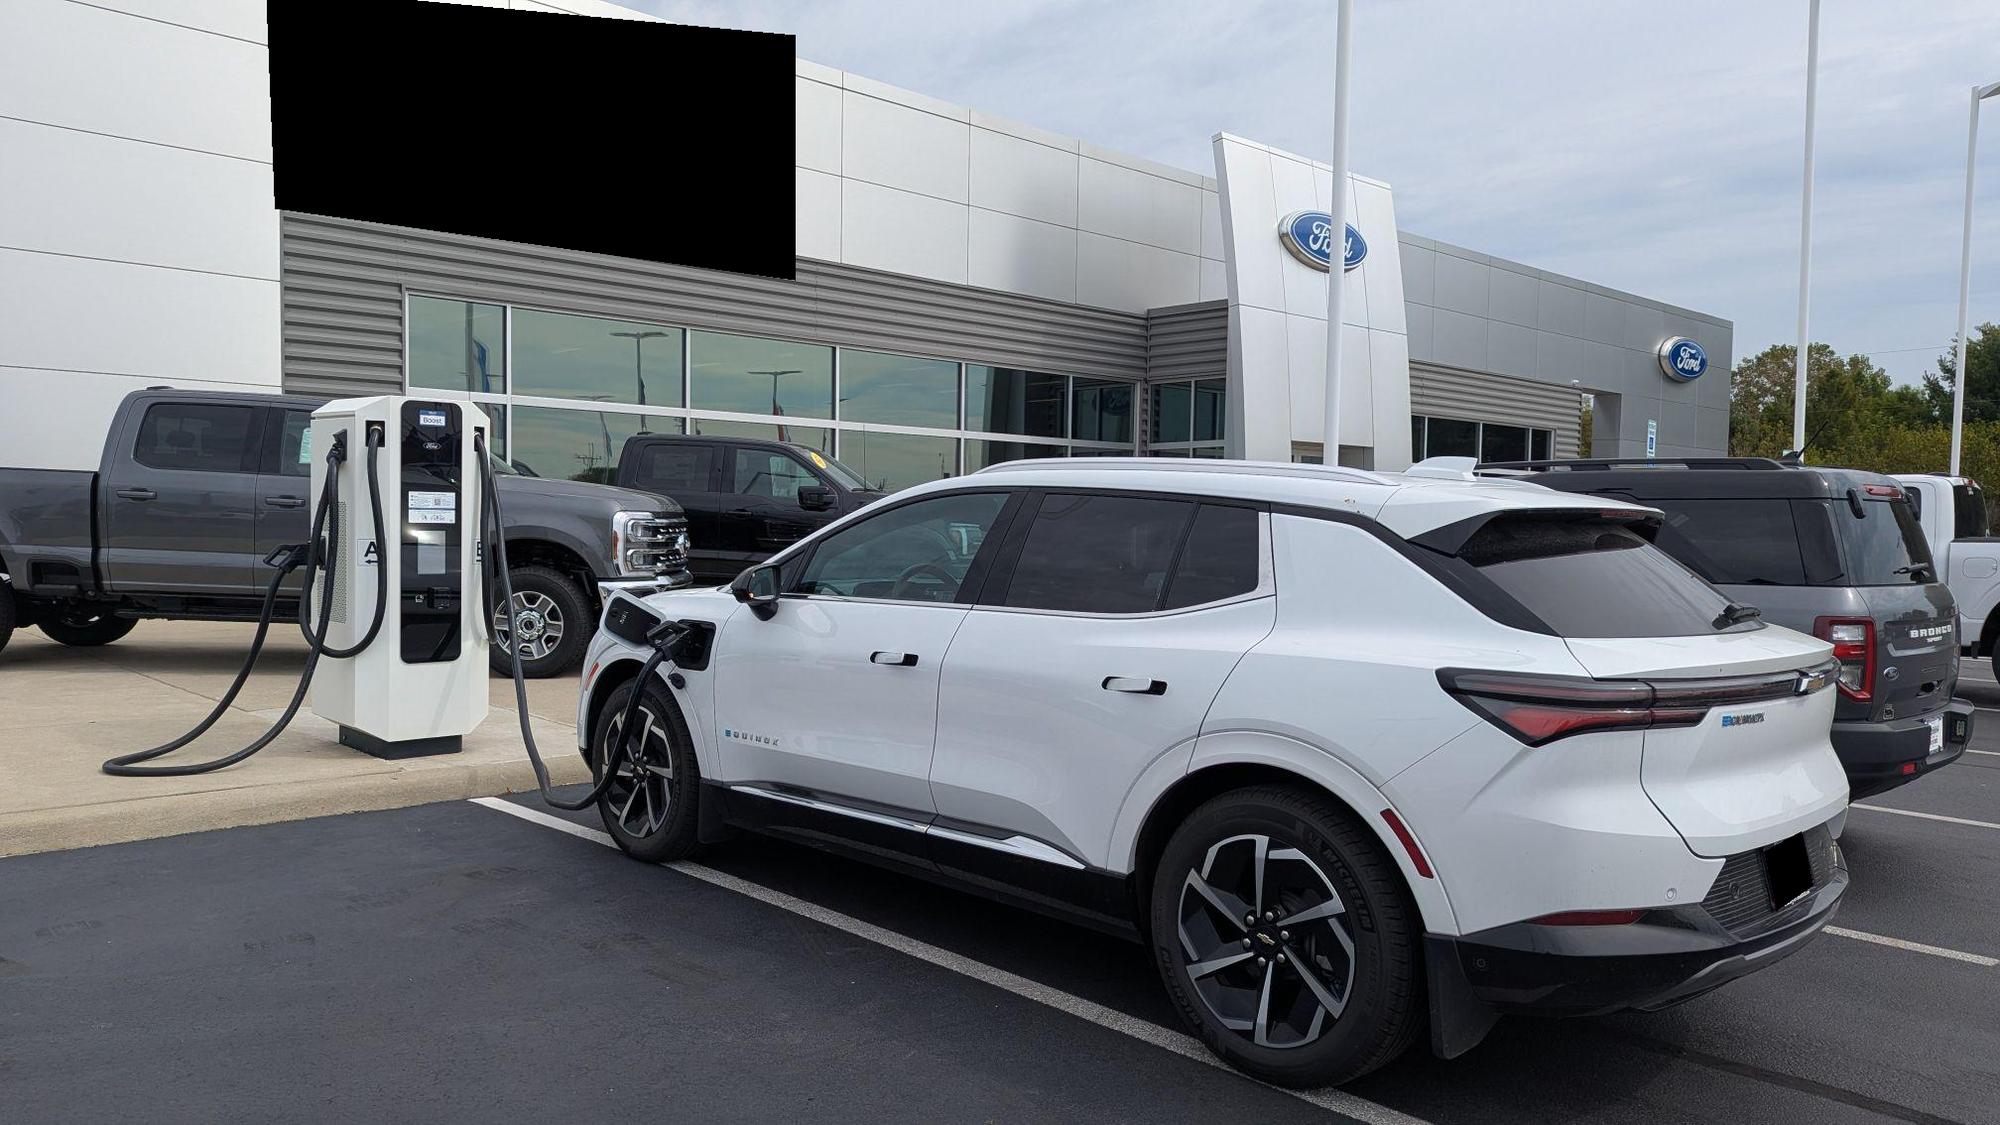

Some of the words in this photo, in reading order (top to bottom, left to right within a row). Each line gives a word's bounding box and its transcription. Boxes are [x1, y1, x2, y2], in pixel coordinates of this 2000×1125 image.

[1309, 221, 1353, 258] Fod
[1677, 346, 1702, 372] Ford
[423, 417, 443, 425] Boost
[364, 541, 378, 557] A
[1910, 624, 1952, 638] BRONCO
[725, 729, 780, 746] EQUINOX
